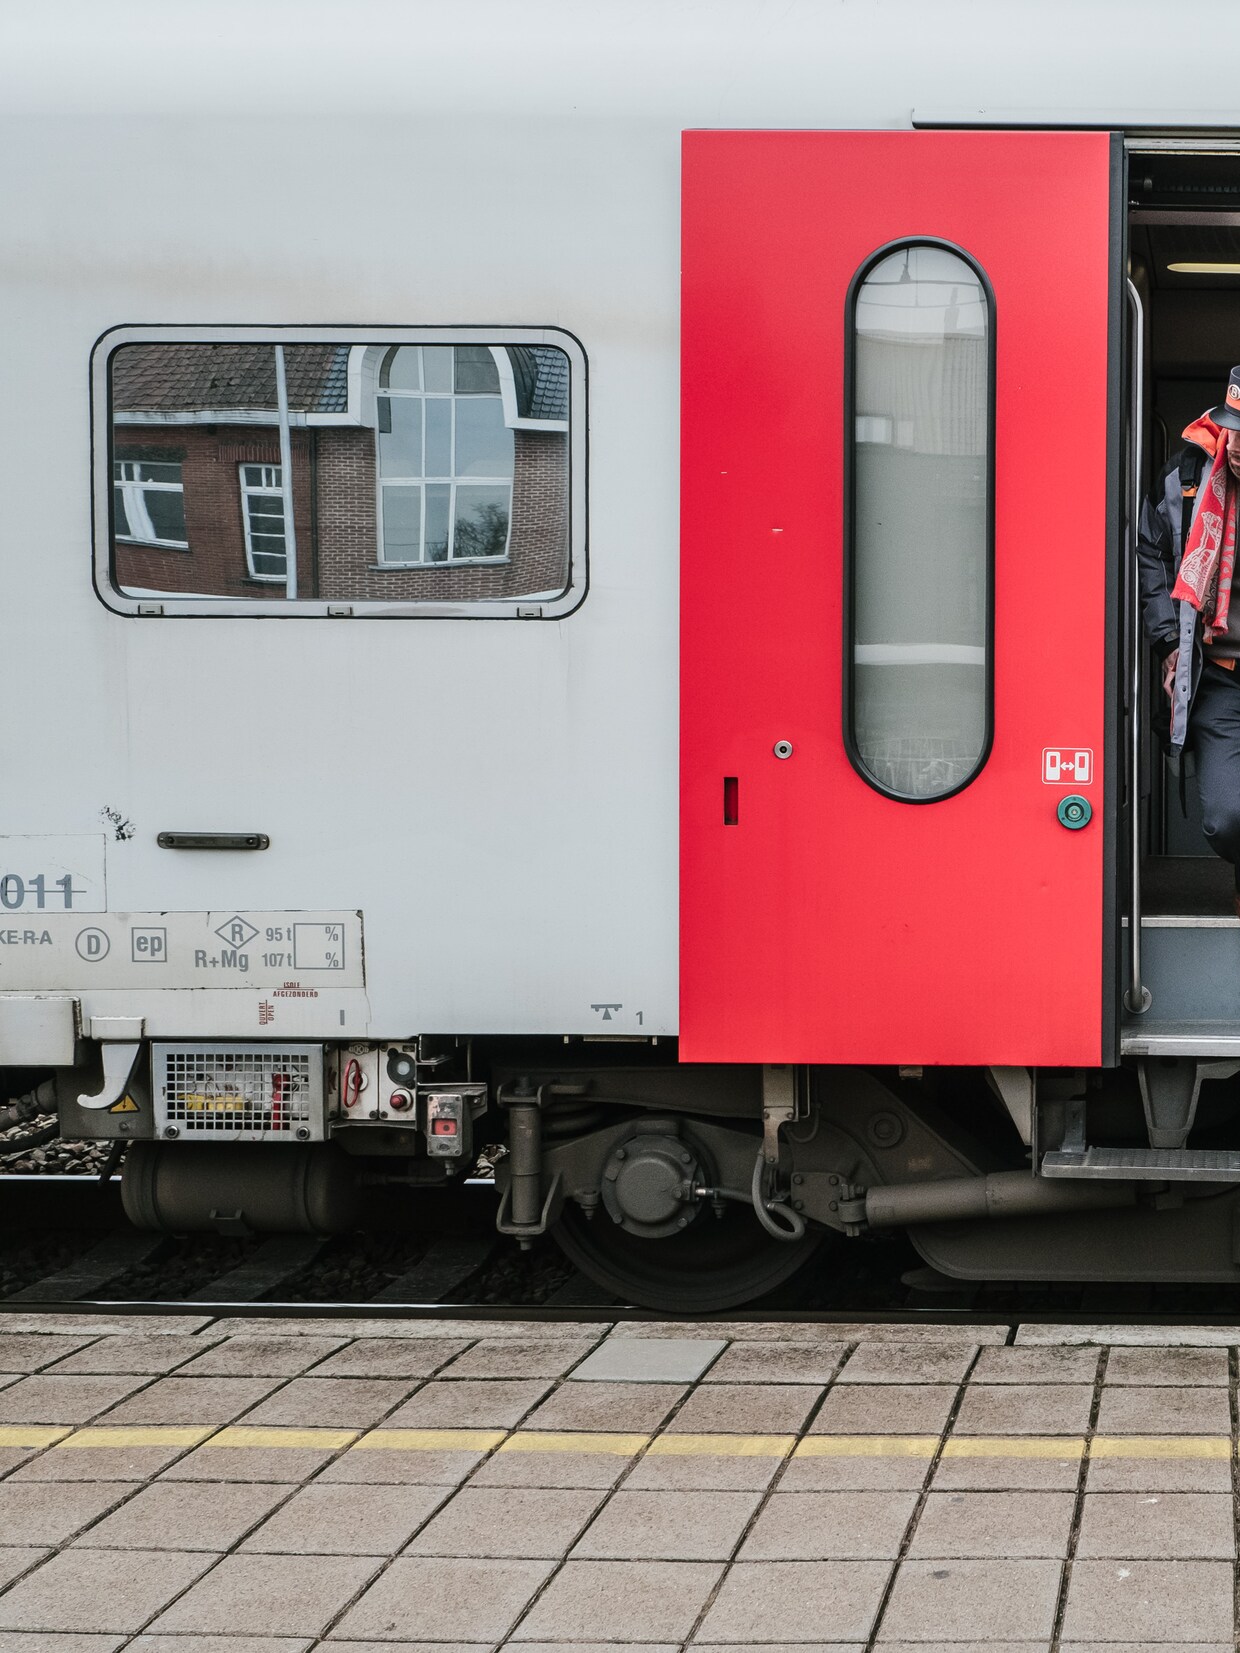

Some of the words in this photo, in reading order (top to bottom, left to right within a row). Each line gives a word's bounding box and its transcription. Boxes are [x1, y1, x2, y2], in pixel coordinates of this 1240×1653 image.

[0, 873, 73, 909] 011
[231, 923, 244, 942] R
[265, 927, 283, 942] 95
[87, 934, 101, 955] D
[136, 935, 163, 957] ep
[194, 949, 249, 973] R+Mg
[261, 953, 284, 968] 107
[272, 990, 319, 998] AFGEZONDERD
[267, 1004, 275, 1021] OPEN
[635, 1010, 643, 1026] 1
